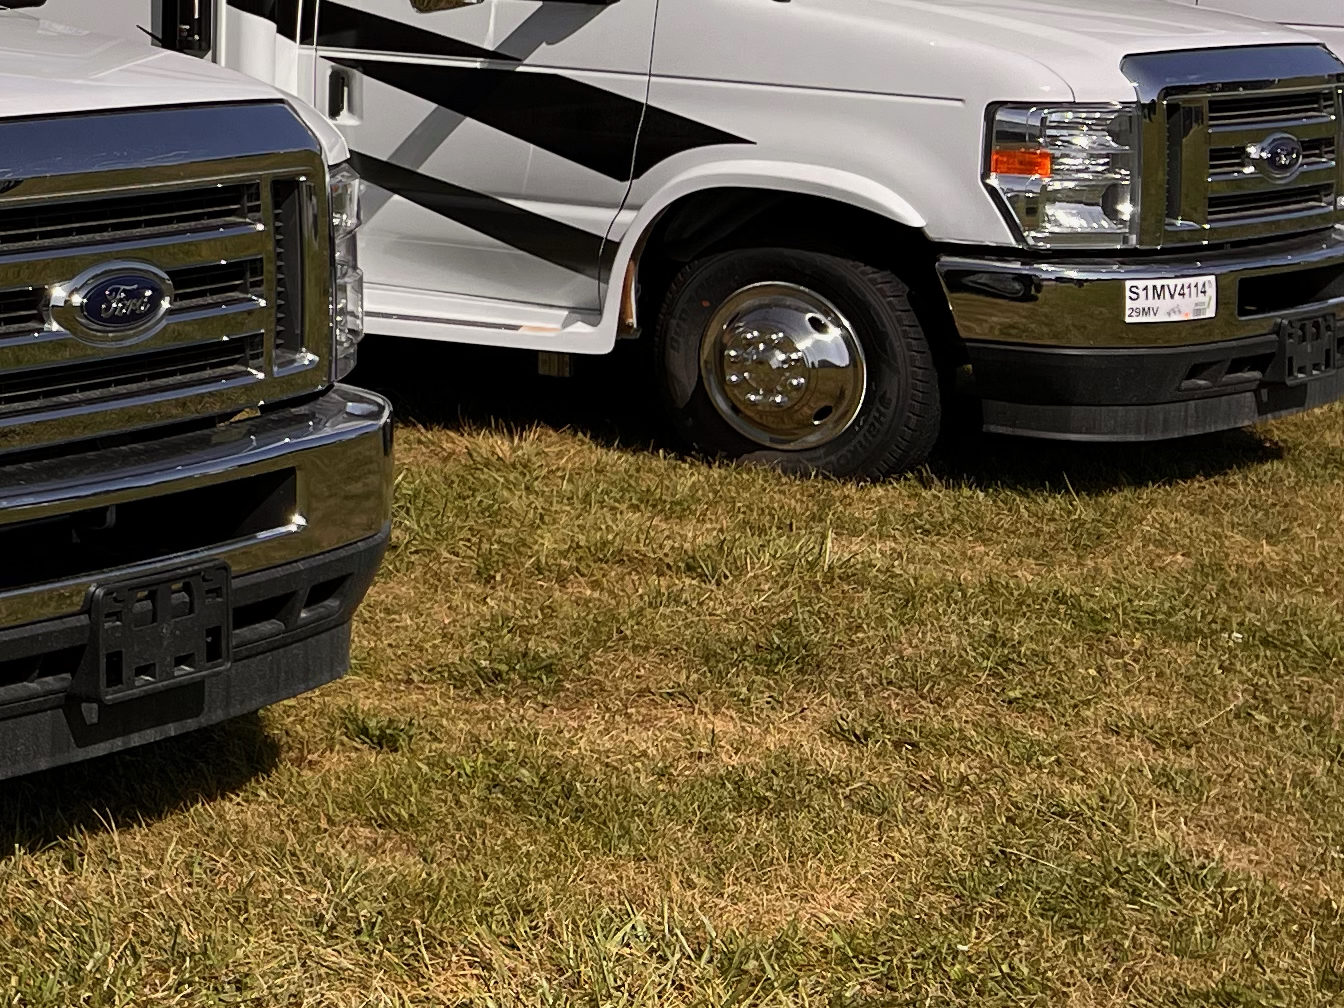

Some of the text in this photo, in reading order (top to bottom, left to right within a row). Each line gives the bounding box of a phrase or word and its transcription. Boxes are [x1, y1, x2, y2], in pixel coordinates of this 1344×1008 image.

[100, 284, 153, 319] Ford
[1128, 280, 1208, 302] S1MV4114
[1127, 306, 1160, 318] 29MV
